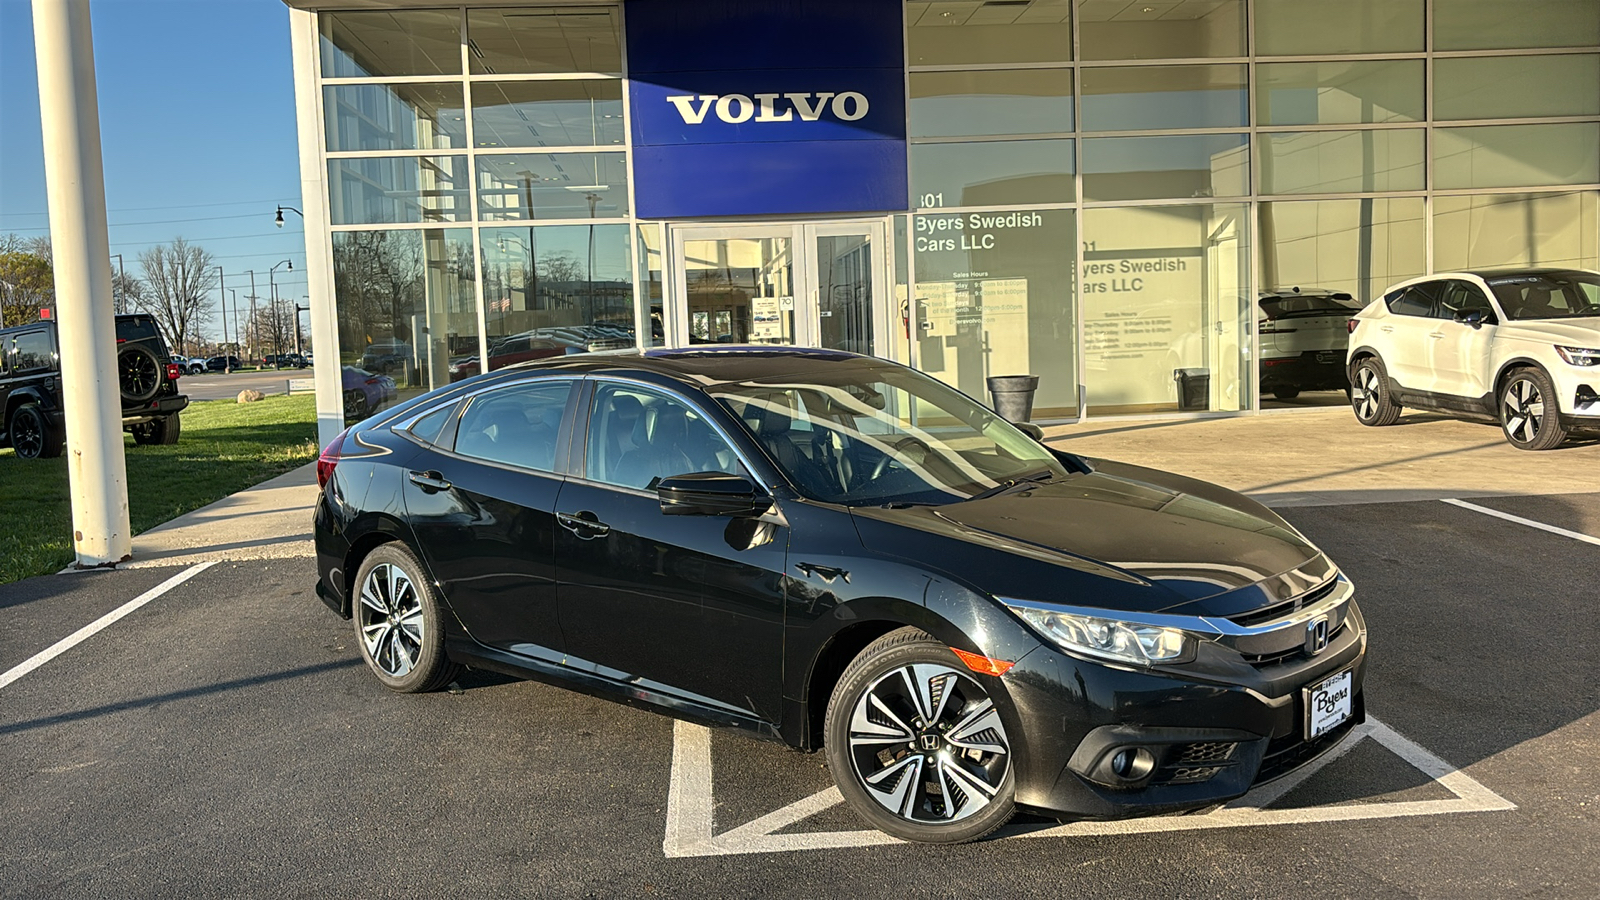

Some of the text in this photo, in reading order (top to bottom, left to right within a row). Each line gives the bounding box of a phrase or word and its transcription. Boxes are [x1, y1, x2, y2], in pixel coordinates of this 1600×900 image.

[666, 91, 870, 125] VOLVO
[917, 212, 1042, 235] Byers Swedish
[917, 233, 995, 252] Cars LLC
[1083, 258, 1187, 278] yers Swedish
[1083, 277, 1144, 294] ars LLC
[1314, 687, 1347, 713] Byers
